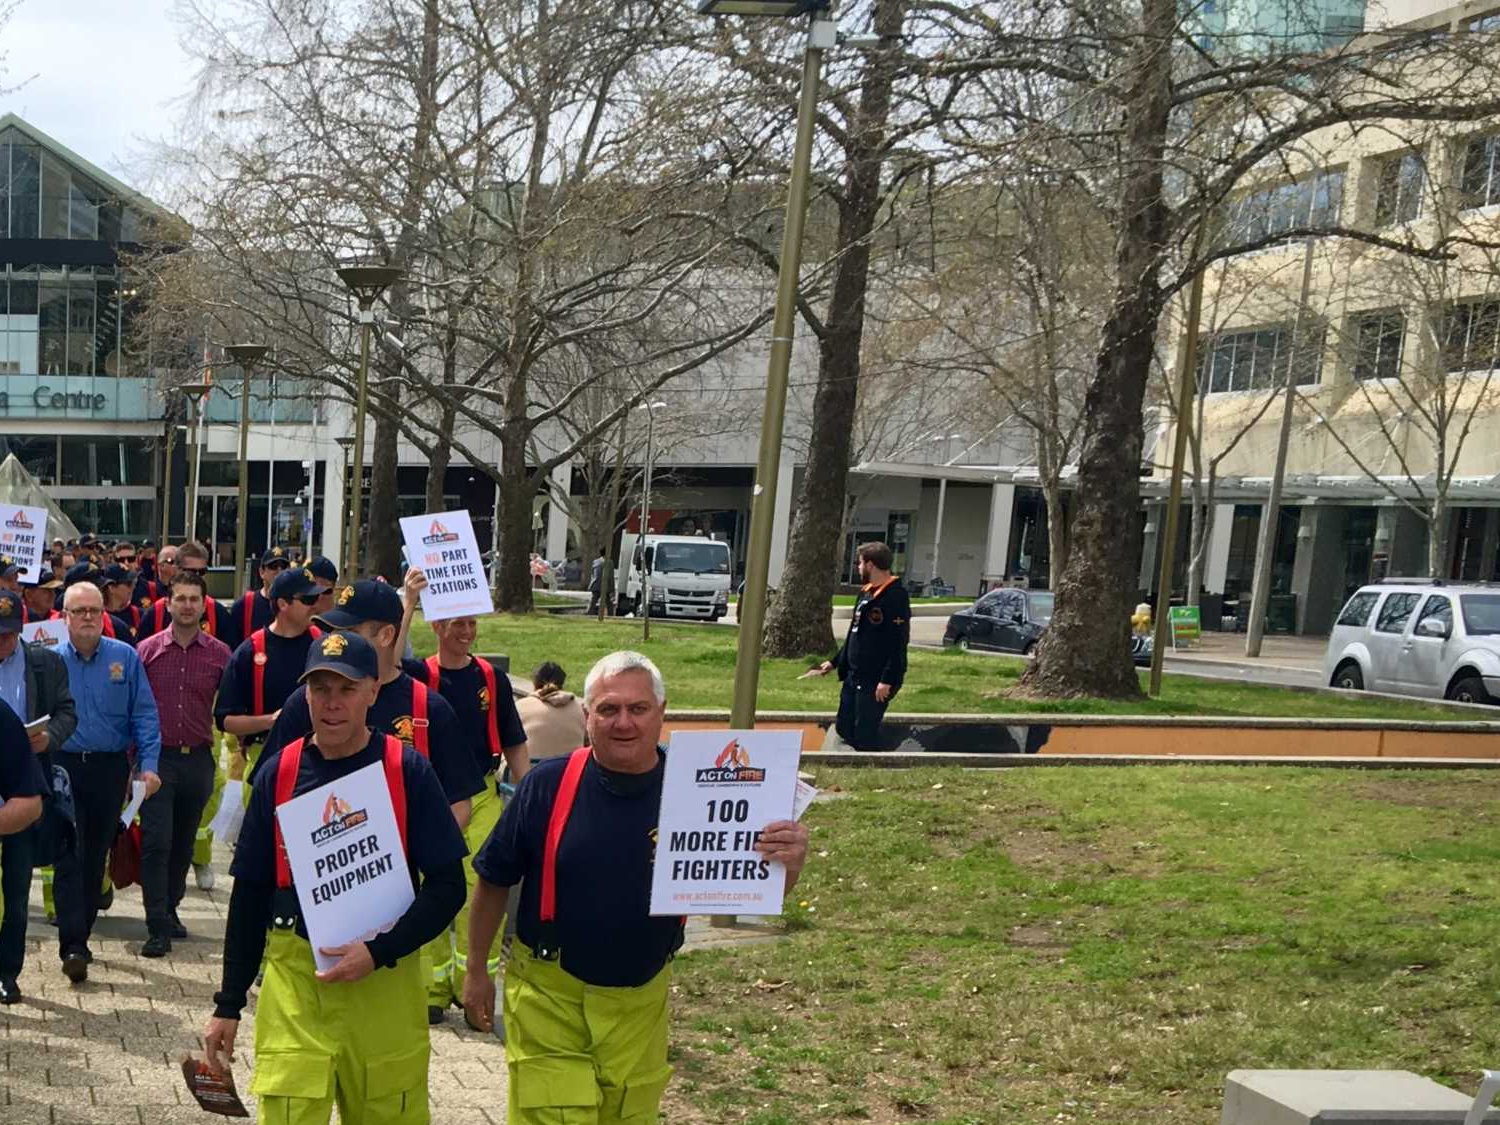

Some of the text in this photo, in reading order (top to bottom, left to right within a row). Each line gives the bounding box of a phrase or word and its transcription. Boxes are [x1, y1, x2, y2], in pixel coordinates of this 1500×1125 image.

[33, 385, 106, 409] Centre
[15, 534, 36, 545] PART
[0, 543, 35, 556] TIME FIRE
[441, 548, 468, 562] PART
[425, 563, 474, 580] TIME FIRE
[429, 578, 478, 595] STATIONS
[698, 770, 763, 781] ACT ON FIRE
[707, 799, 749, 823] 100
[314, 826, 334, 843] ACT
[669, 831, 728, 852] MORE
[314, 834, 380, 878] PROPER
[671, 860, 770, 881] FIGHTERS
[311, 853, 393, 906] EQUIPMENT
